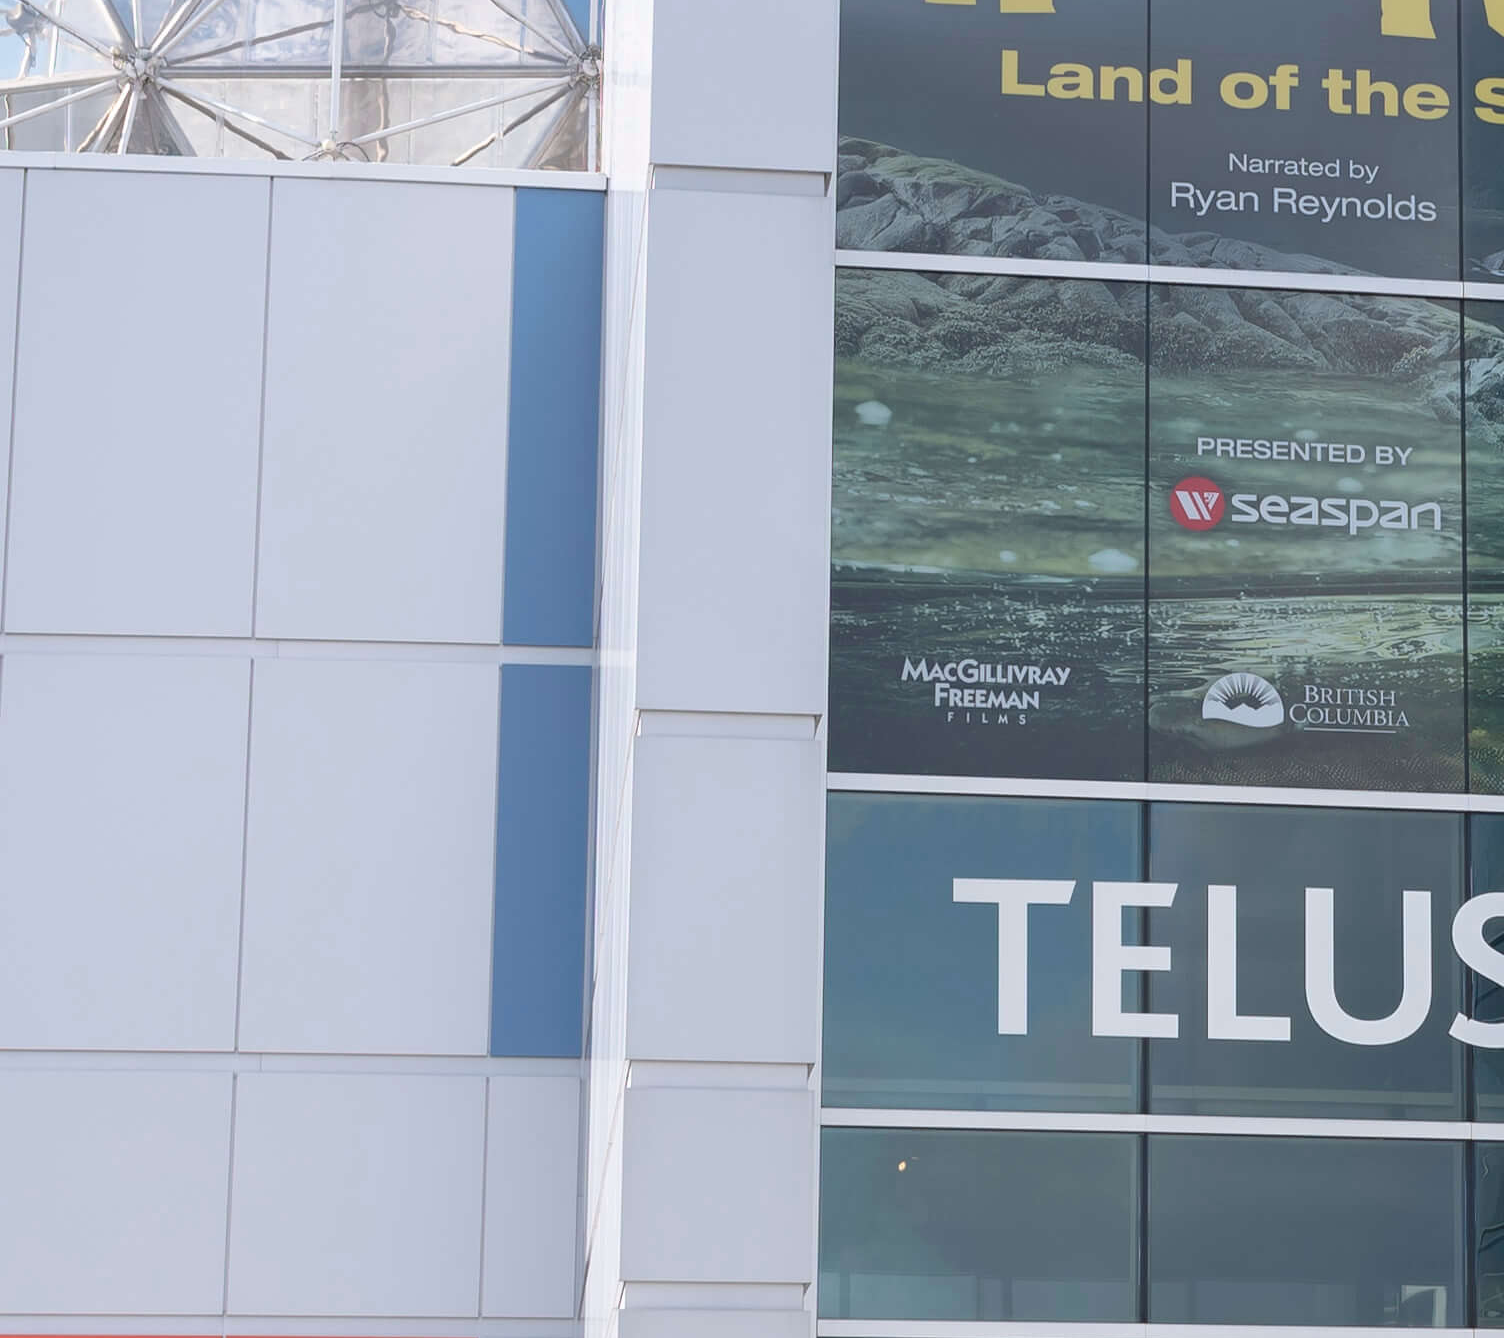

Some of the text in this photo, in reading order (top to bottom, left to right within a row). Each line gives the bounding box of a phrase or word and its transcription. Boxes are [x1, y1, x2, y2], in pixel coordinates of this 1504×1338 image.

[1001, 50, 1193, 106] Land
[1219, 65, 1299, 112] of
[1322, 68, 1450, 121] the
[1228, 153, 1379, 184] Narrated by
[1169, 181, 1437, 223] Ryan Reynolds
[1197, 437, 1413, 465] PRESENTED BY
[1231, 494, 1441, 535] seaspan
[934, 683, 1039, 709] FREEMAN
[1303, 685, 1396, 707] BRITISH
[947, 712, 1026, 725] FILMS
[1289, 704, 1410, 728] COLUMBIA
